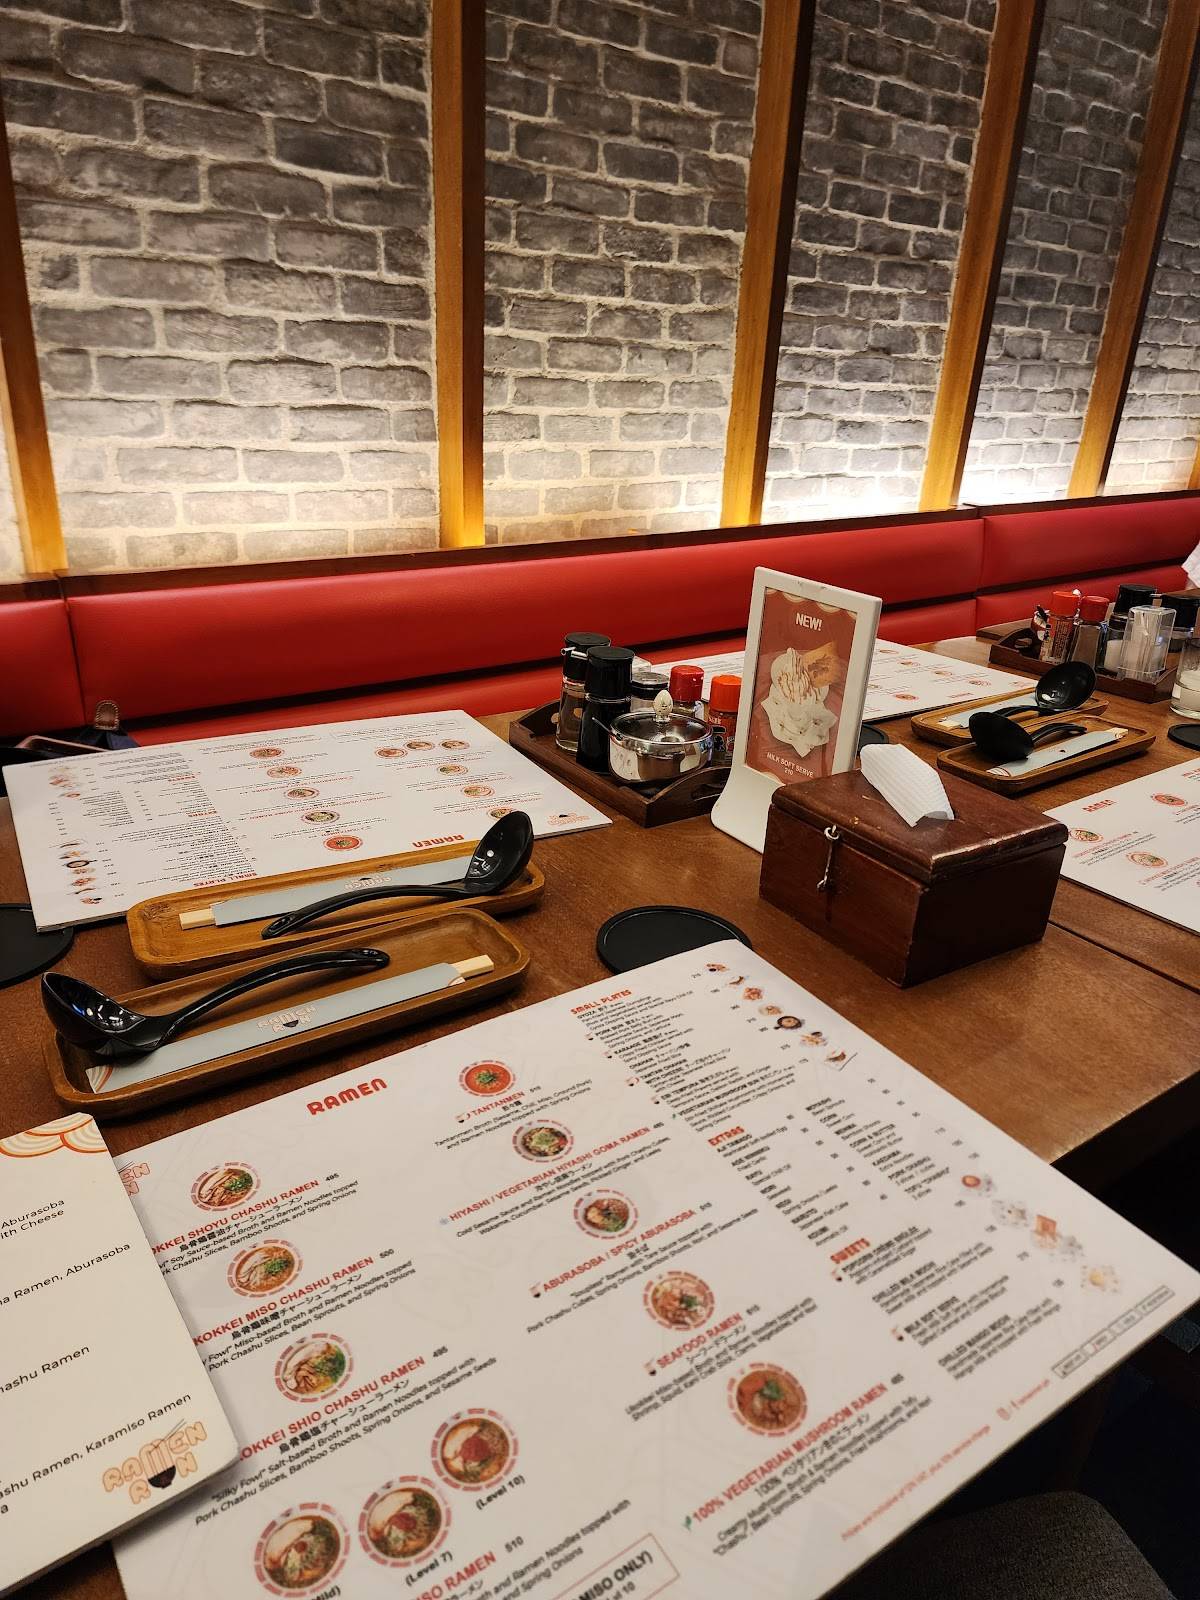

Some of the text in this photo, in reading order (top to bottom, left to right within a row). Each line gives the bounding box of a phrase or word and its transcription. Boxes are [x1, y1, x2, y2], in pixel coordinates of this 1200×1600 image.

[796, 612, 823, 631] NEW!
[781, 758, 795, 769] SOFT
[795, 765, 814, 778] SERVE
[411, 834, 465, 848] RAMEN
[571, 990, 632, 1015] SMALL PLATES
[307, 1078, 387, 1115] RAMEN
[471, 1092, 525, 1116] TANTANMEN
[708, 1126, 745, 1146] EXTRAS
[449, 1199, 491, 1221] HIYASHI
[495, 1169, 556, 1200] VEGETARIAN
[556, 1152, 593, 1172] HIYASHI
[593, 1141, 620, 1155] GOMA
[619, 1127, 650, 1143] RAMEN
[0, 1210, 64, 1239] ith Cheese
[1, 1200, 64, 1229] Aburasoba
[188, 1217, 228, 1239] SHOYU
[231, 1197, 278, 1221] CHASHU
[280, 1180, 319, 1200] RAMEN
[543, 1256, 606, 1292] ABURASOBA
[610, 1237, 638, 1256] SPICY
[640, 1210, 696, 1241] ABURASOBA
[14, 1244, 131, 1298] Ramen, Aburasoba
[245, 1302, 277, 1322] MISO
[280, 1277, 330, 1305] CHASHU
[332, 1257, 374, 1280] RAMEN
[42, 1345, 90, 1373] Ramen
[656, 1335, 707, 1368] SEAFOOD
[706, 1313, 743, 1338] RAMEN
[288, 1411, 322, 1434] SHIO
[324, 1381, 379, 1415] CHASHU
[380, 1357, 425, 1385] RAMEN
[33, 1453, 83, 1481] Ramen,
[86, 1419, 145, 1453] Karamiso
[148, 1394, 191, 1420] Ramen
[693, 1499, 725, 1522] 100%
[722, 1448, 794, 1500] VEGETARIAN
[792, 1407, 853, 1453] MUSHROOM
[851, 1383, 888, 1411] RAMEN
[103, 1421, 207, 1492] RAMEN
[476, 1475, 525, 1510] (Level 10)
[405, 1551, 453, 1587] (Level 7)
[444, 1552, 496, 1591] RAMEN
[505, 1536, 524, 1553] 510
